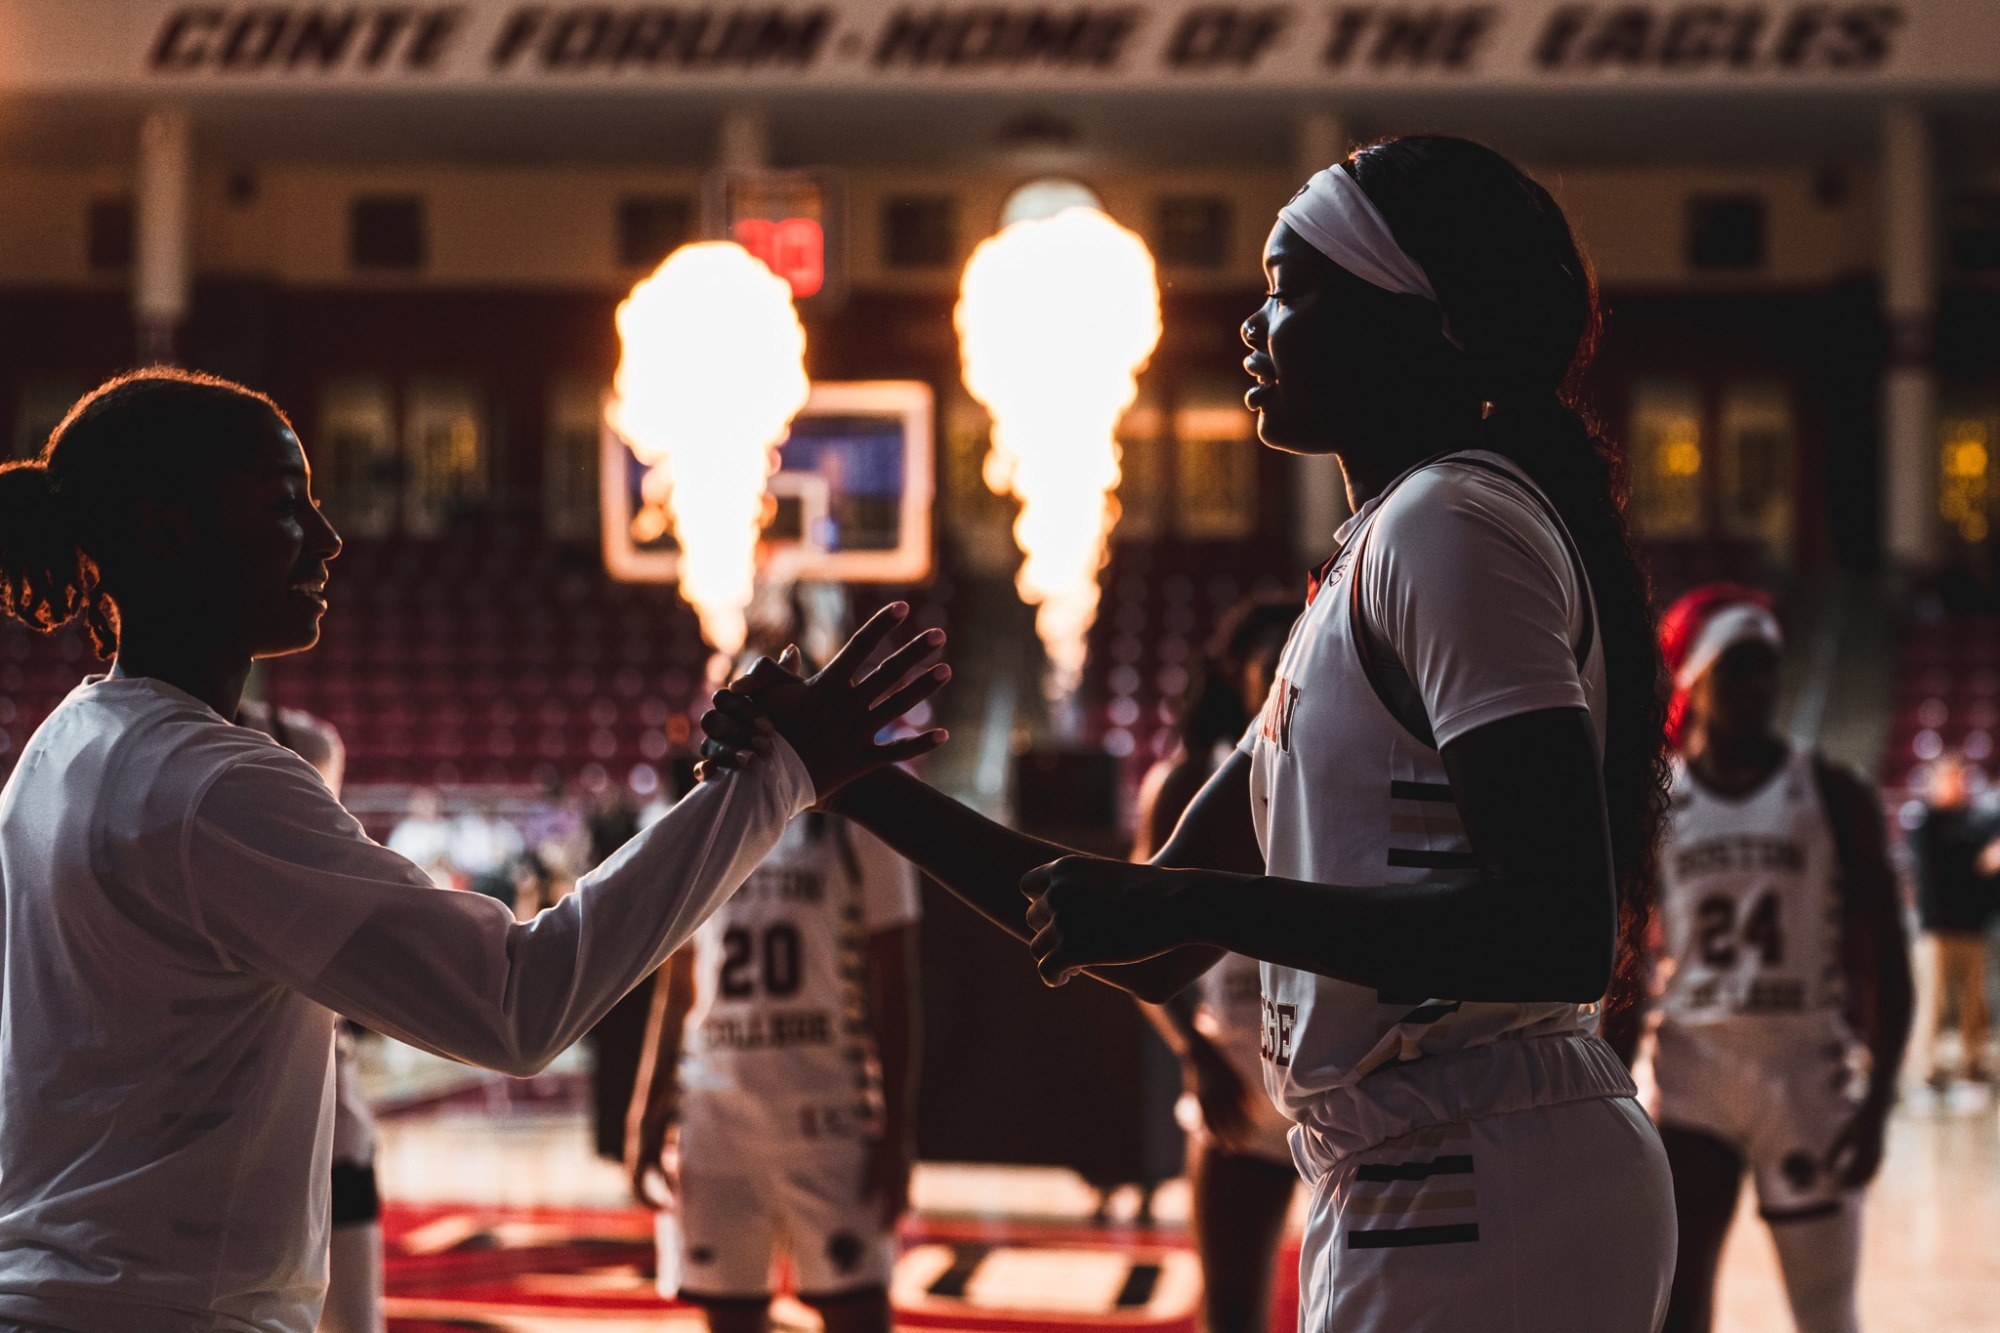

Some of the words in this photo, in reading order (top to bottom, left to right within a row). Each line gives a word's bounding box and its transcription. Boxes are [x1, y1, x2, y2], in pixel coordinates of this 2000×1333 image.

[149, 8, 464, 71] CONTE
[489, 8, 830, 71] FORUM
[870, 8, 1142, 71] HOME
[1162, 8, 1291, 71] OF
[1320, 8, 1495, 71] THE
[1530, 8, 1907, 71] EAGLES
[721, 925, 803, 999] 20
[1699, 889, 1783, 968] 24
